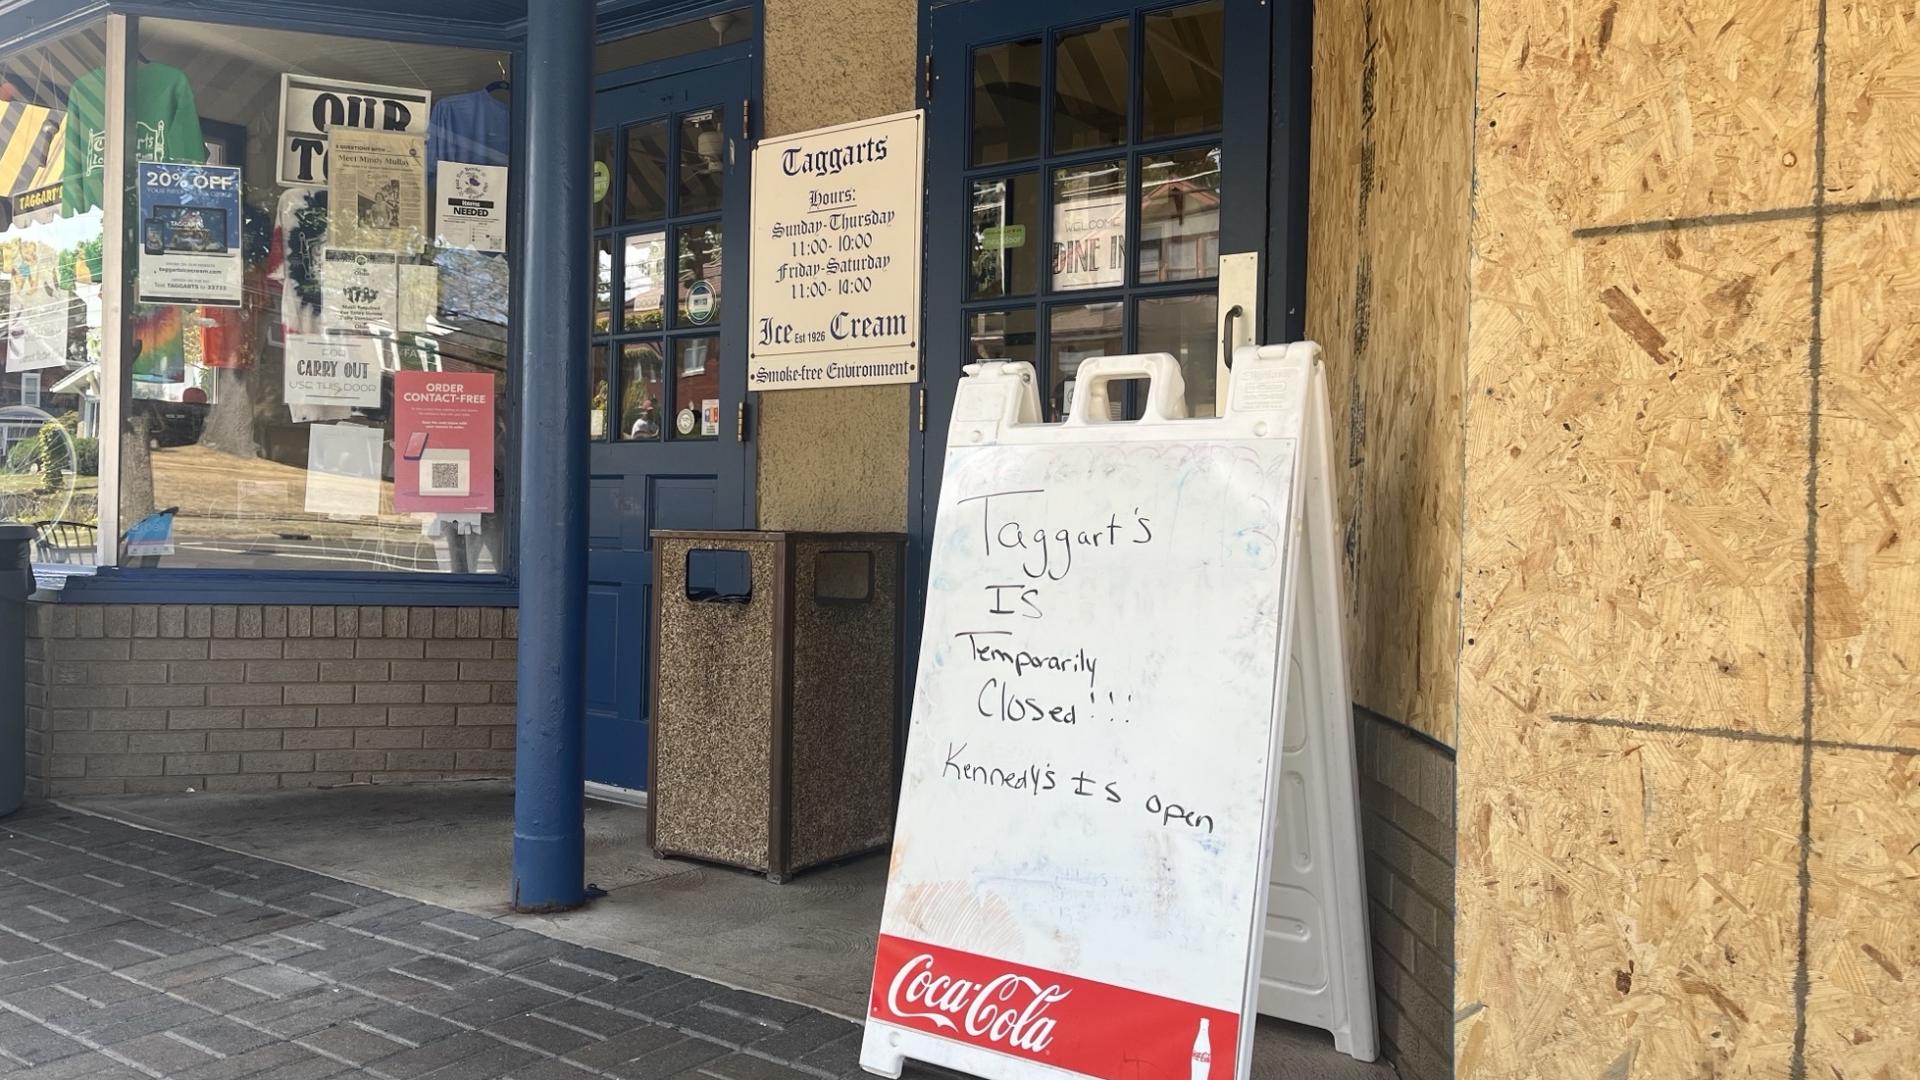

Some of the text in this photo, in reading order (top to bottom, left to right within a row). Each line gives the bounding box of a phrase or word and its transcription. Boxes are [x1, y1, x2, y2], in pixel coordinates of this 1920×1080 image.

[146, 171, 233, 191] 20% OFF
[808, 187, 856, 209] Hours:
[453, 207, 489, 217] NEEDED
[771, 209, 895, 239] Sunday-Thursday
[1064, 216, 1121, 233] WELCOME
[775, 254, 891, 284] Friday-Saturday
[1052, 238, 1101, 275] DINE
[758, 311, 907, 347] Ice Est 1926 Cream
[296, 360, 370, 379] CARRY OUT
[755, 358, 910, 384] Smoke-free Environment
[288, 380, 313, 390] USE
[343, 383, 377, 393] DOOR
[403, 392, 487, 404] CONTACT-FREE
[426, 383, 464, 394] ORDER
[957, 489, 1153, 580] Taggart's
[954, 631, 1099, 687] Temporarily
[942, 742, 1056, 797] Kennedy's
[888, 953, 1073, 1054] Coca-Cola
